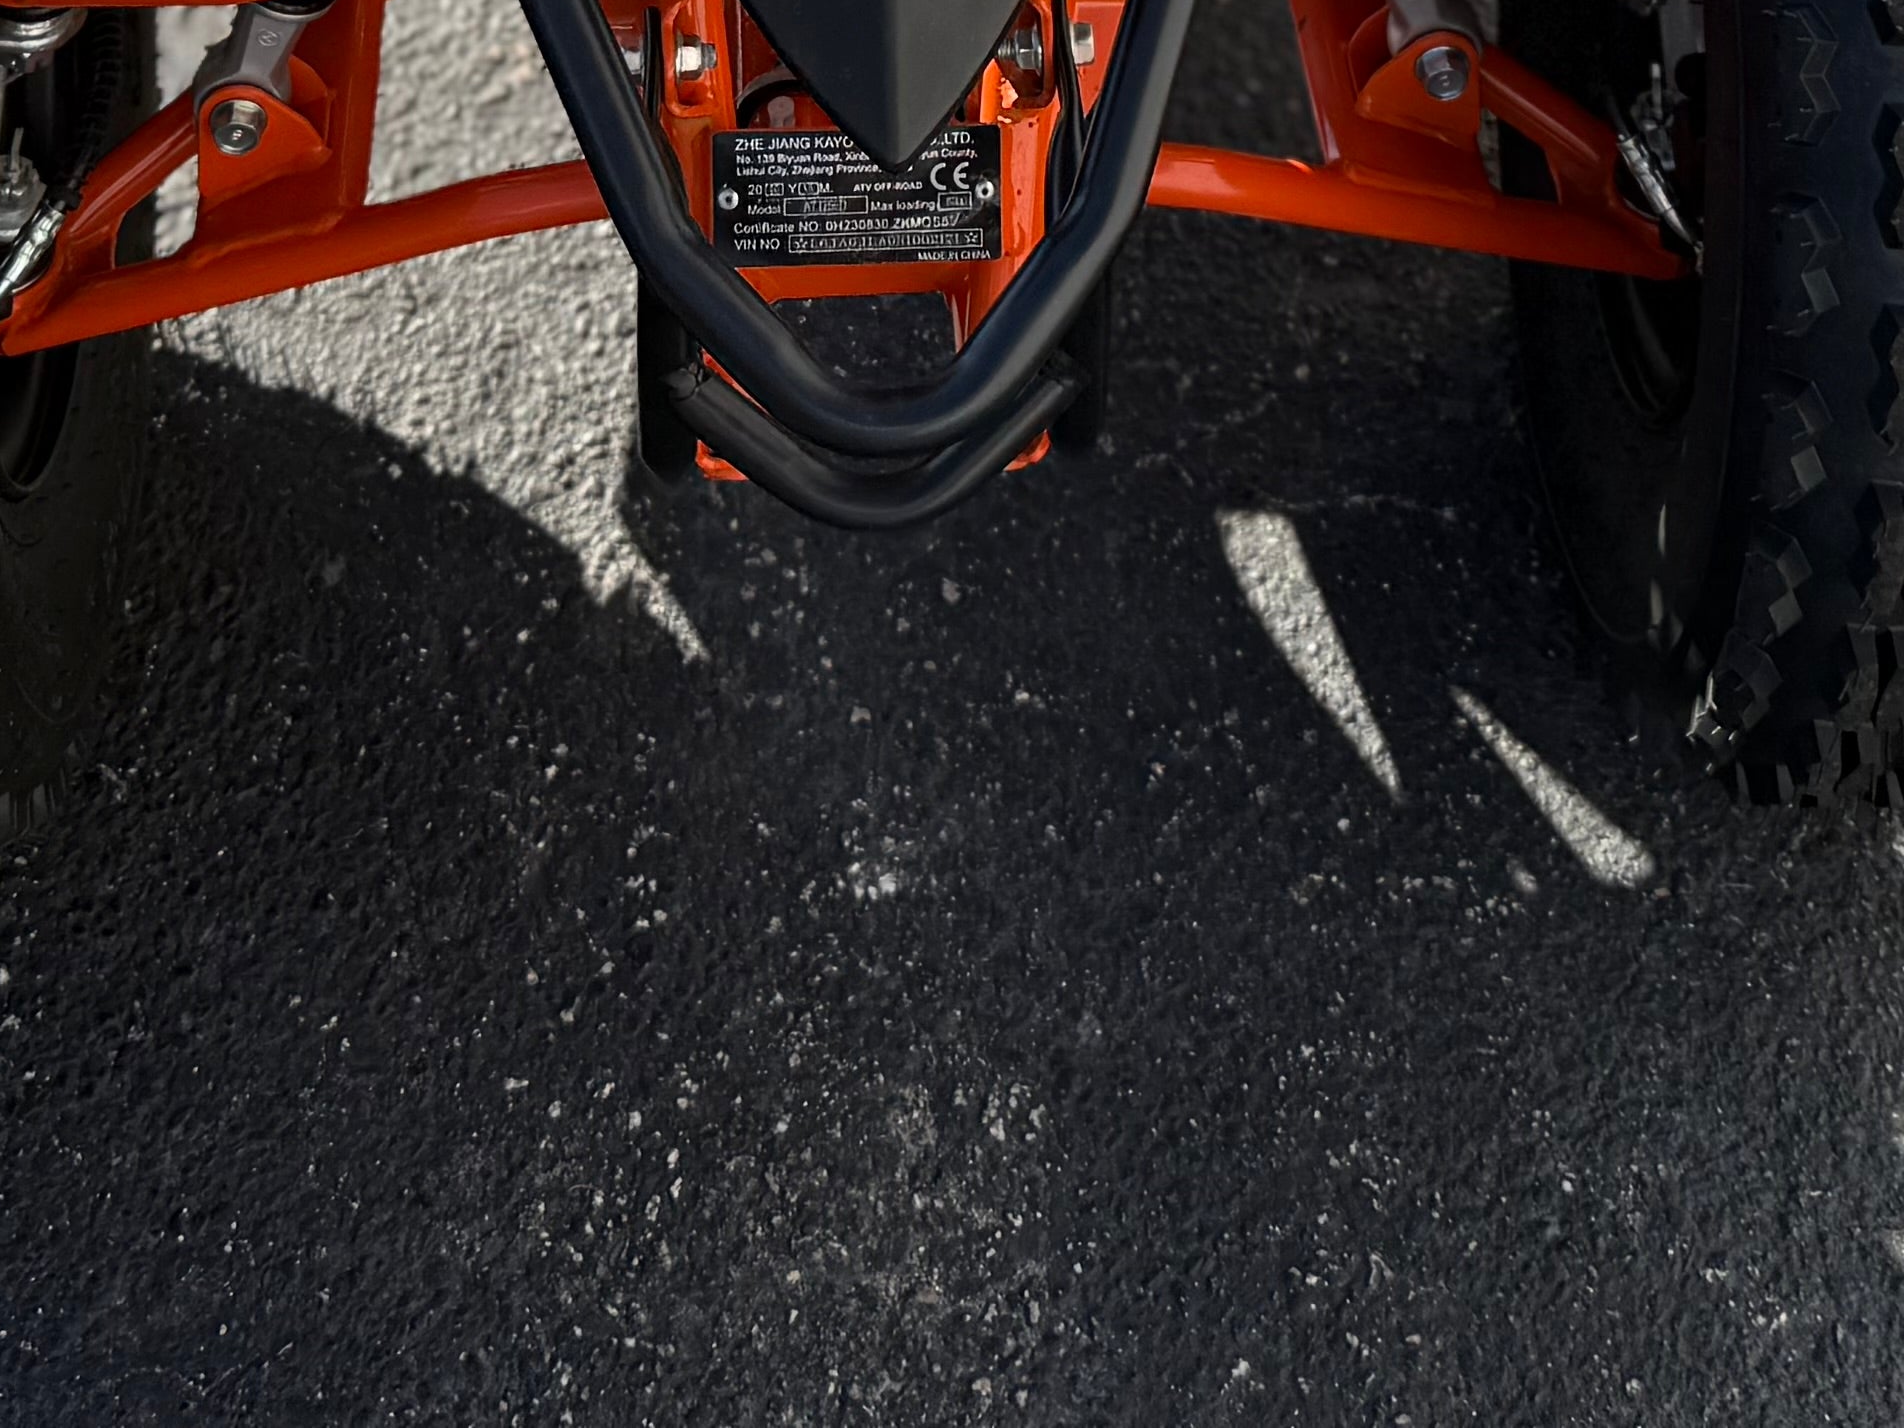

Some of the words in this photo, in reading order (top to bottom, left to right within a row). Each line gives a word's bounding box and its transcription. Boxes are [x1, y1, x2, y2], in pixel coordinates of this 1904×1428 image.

[734, 137, 765, 151] ZHE
[768, 136, 812, 150] JIANG
[930, 161, 970, 191] CE
[853, 182, 873, 192] ATV
[747, 204, 782, 215] Model
[734, 239, 757, 251] VIN
